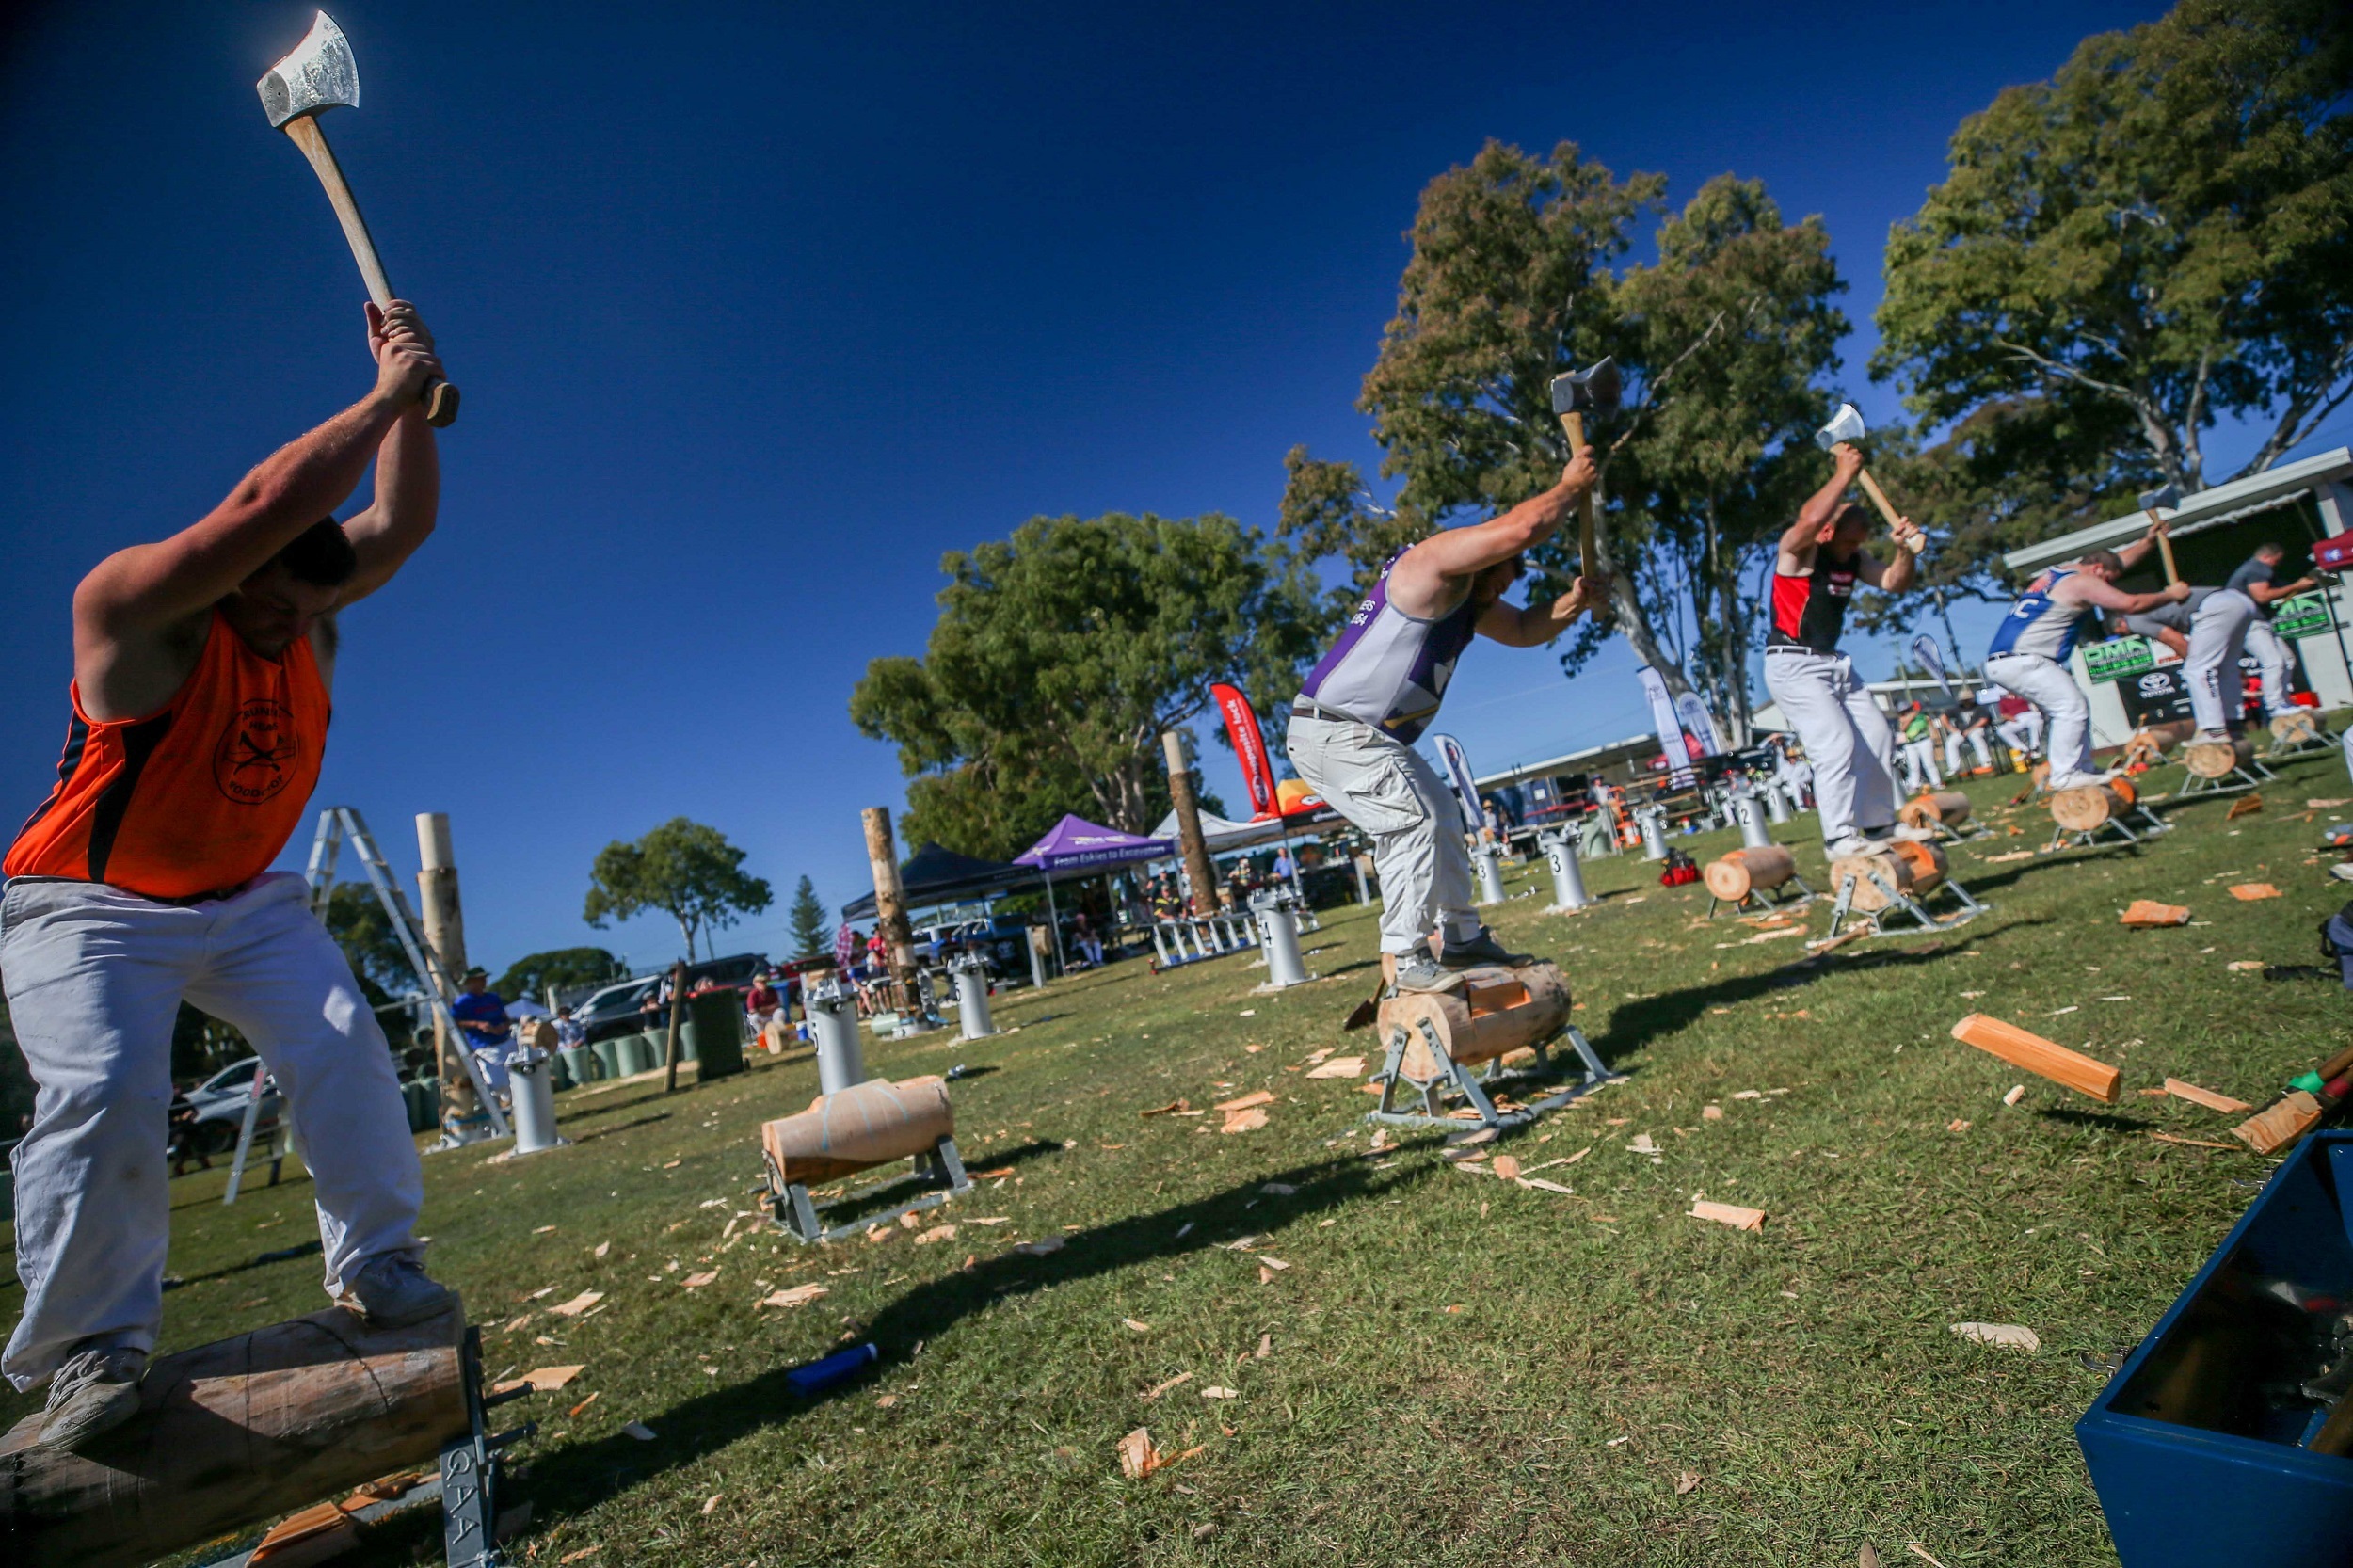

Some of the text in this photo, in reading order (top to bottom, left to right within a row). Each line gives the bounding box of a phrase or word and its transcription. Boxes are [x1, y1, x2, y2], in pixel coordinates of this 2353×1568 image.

[1226, 698, 1242, 725] lock
[1740, 808, 1751, 825] 2
[1645, 825, 1653, 840] 2
[1054, 856, 1079, 866] From
[1109, 850, 1118, 859] to
[1552, 854, 1561, 873] 3
[1480, 864, 1487, 880] 3
